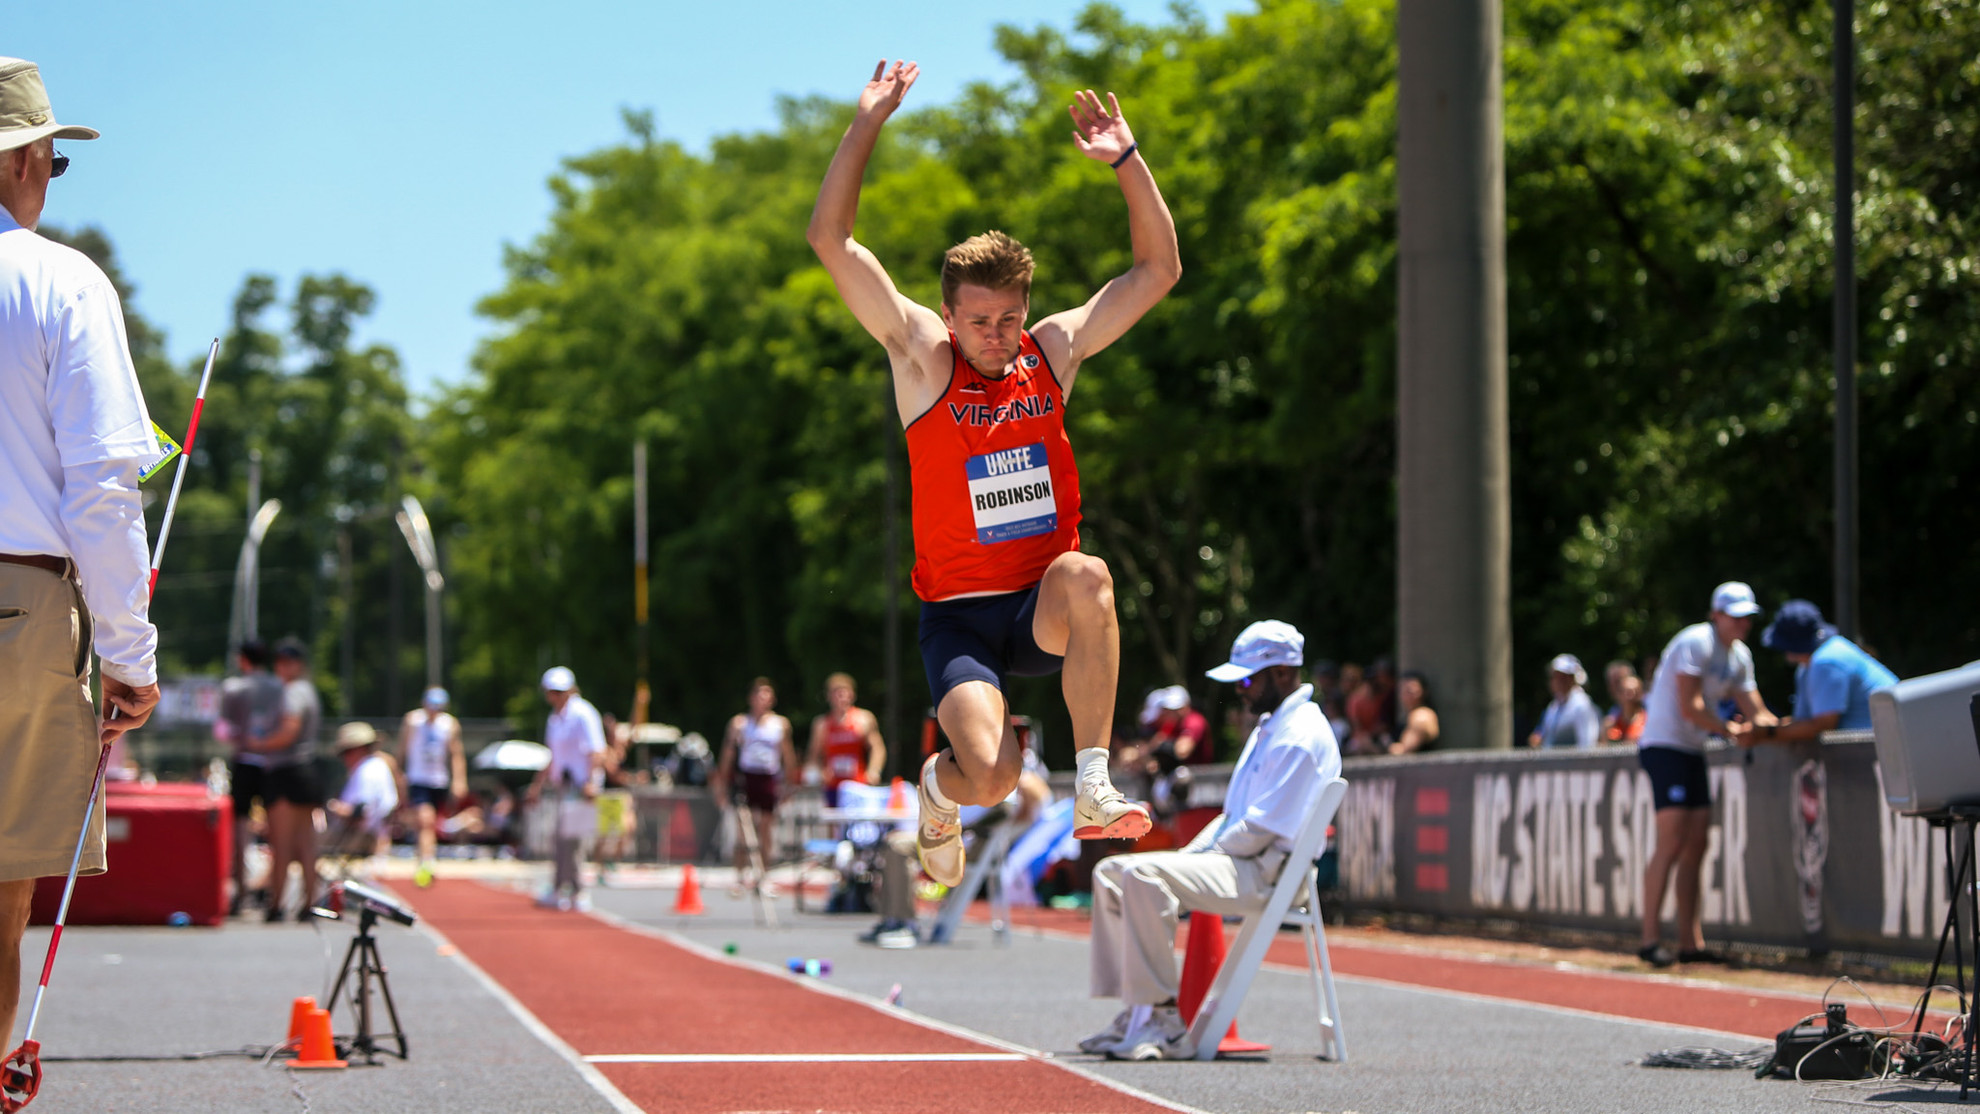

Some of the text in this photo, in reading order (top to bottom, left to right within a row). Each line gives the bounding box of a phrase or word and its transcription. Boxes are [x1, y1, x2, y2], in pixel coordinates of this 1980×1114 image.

[948, 394, 1055, 426] VIRGINIA
[984, 447, 1033, 476] UNITE
[975, 480, 1051, 511] ROBINSON
[1471, 766, 1751, 925] NC STATE SOER
